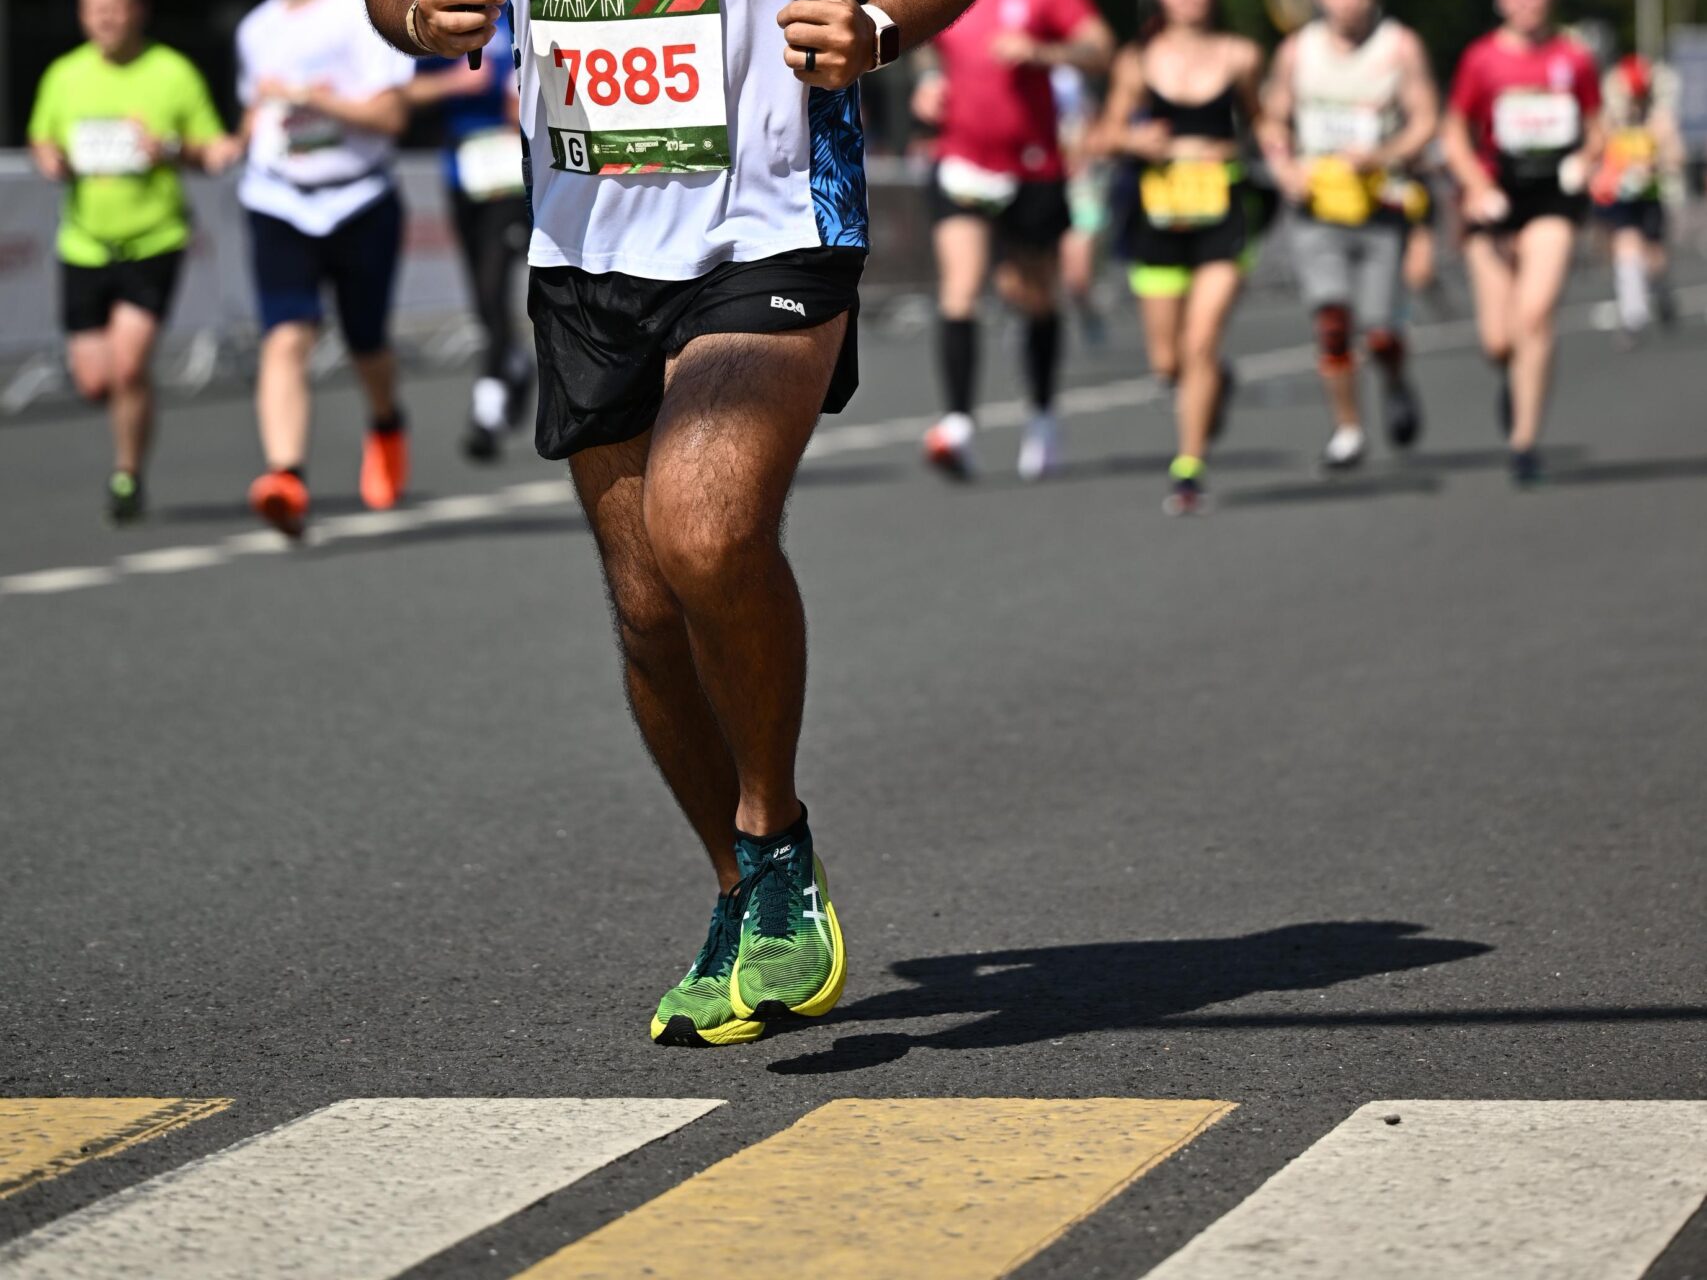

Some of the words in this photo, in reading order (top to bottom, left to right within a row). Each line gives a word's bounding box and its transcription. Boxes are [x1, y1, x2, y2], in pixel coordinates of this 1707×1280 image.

[553, 43, 700, 107] 7885
[568, 137, 584, 167] G
[770, 295, 806, 317] BOA
